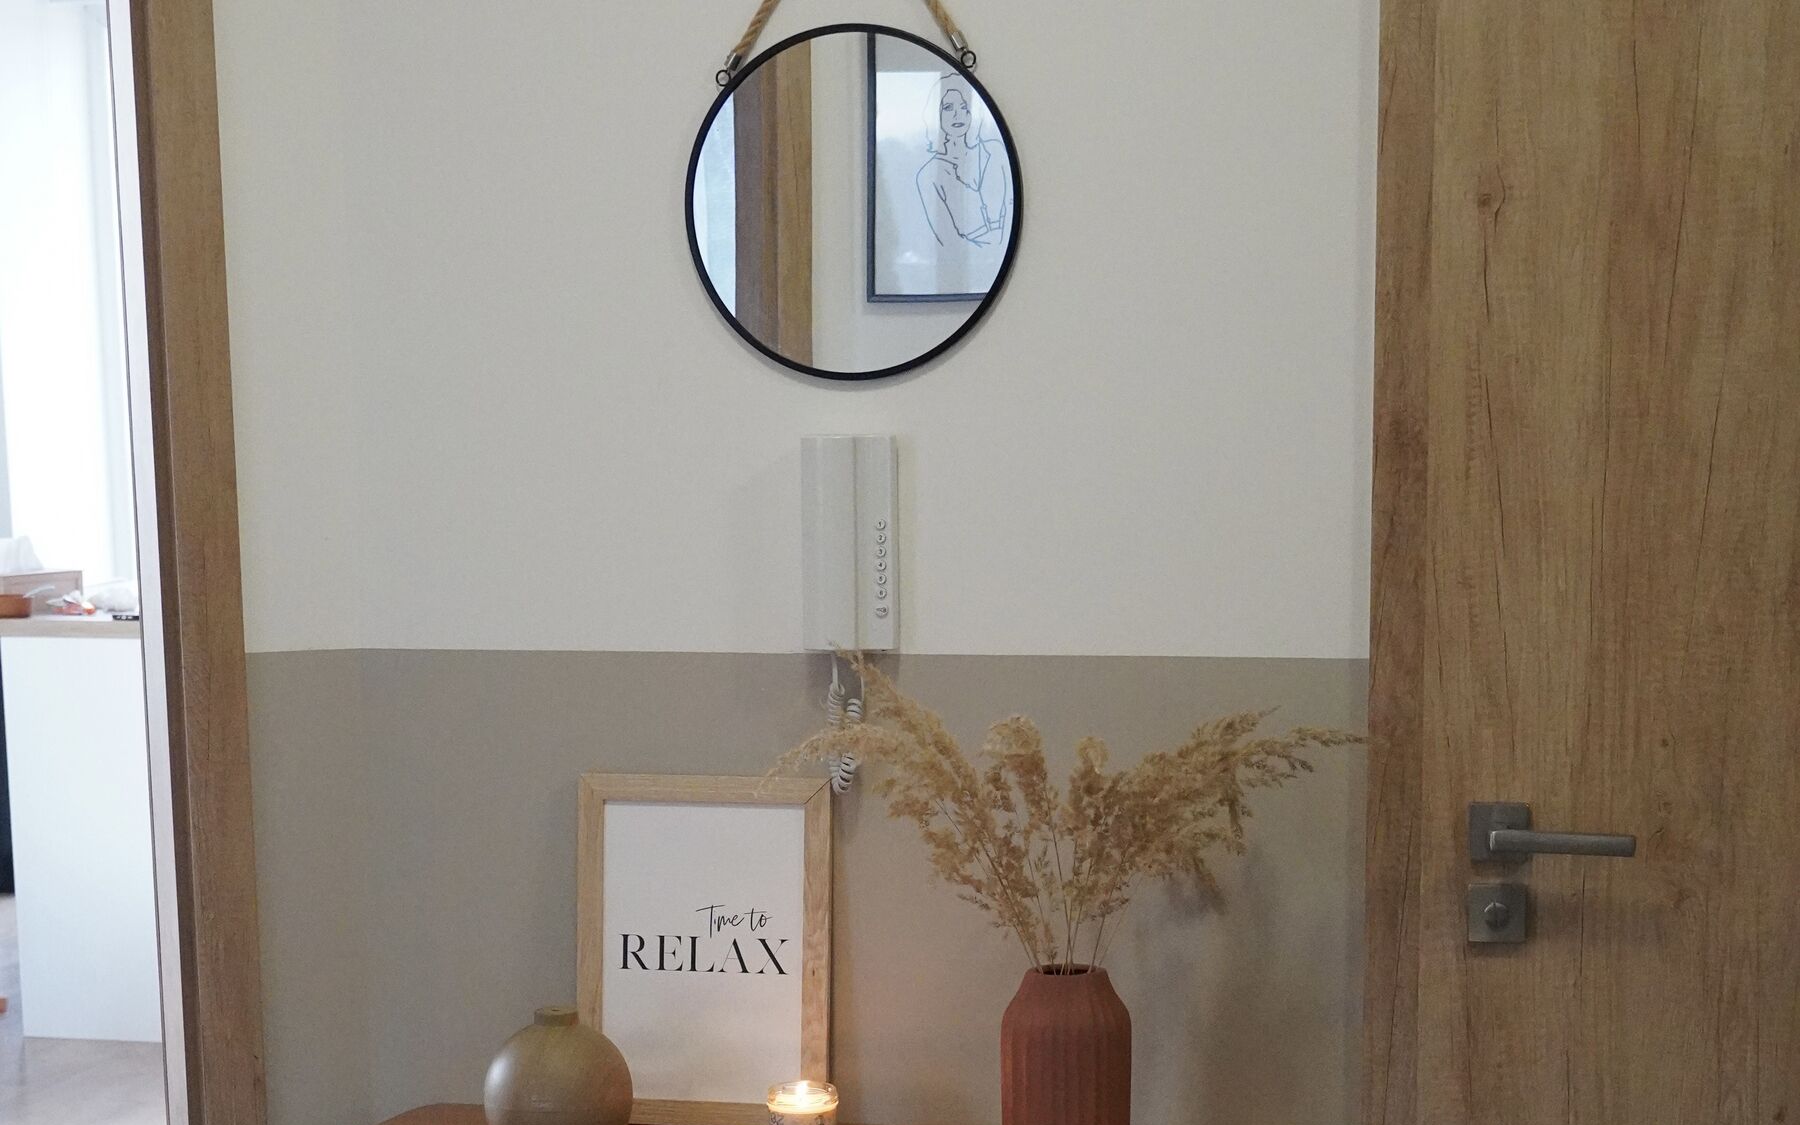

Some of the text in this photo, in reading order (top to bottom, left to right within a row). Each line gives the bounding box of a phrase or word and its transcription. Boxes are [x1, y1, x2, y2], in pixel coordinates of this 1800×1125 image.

[695, 904, 773, 938] Time to
[618, 933, 790, 976] RELAX
